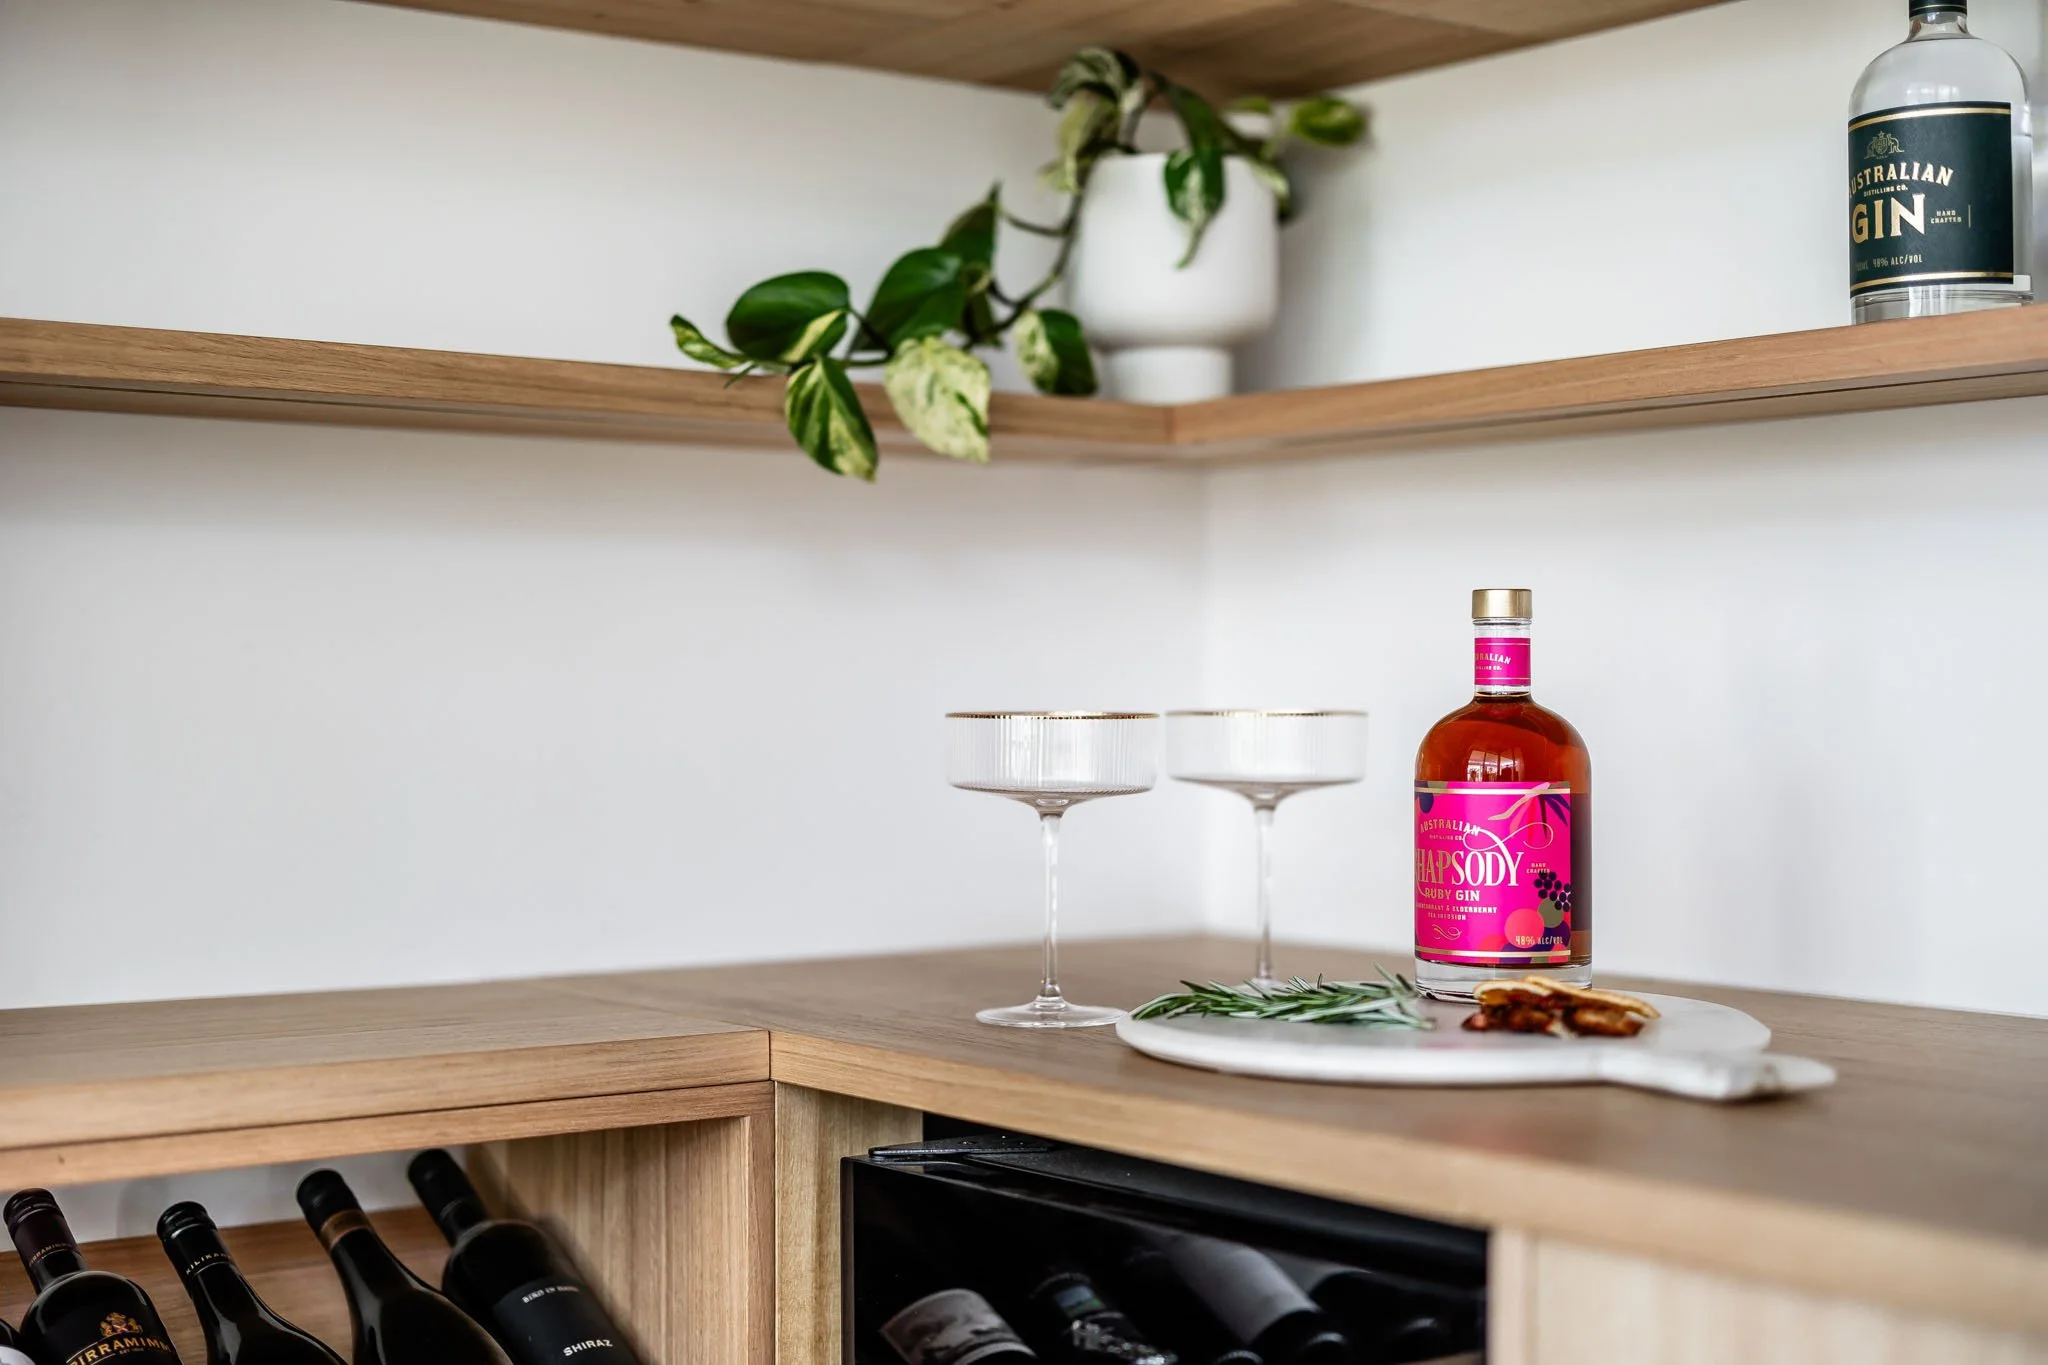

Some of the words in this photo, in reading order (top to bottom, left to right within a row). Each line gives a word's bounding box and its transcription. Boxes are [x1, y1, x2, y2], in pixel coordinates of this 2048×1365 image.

[1864, 185, 1895, 197] DISTILLING
[1852, 193, 1925, 244] GIN
[1930, 216, 1962, 224] CRAFTED
[1890, 254, 1923, 266] ALC/VOL
[1420, 818, 1481, 836] AUSTRALIAN
[1415, 848, 1524, 887] HAPSODY
[1424, 887, 1452, 900] RUBY
[1455, 889, 1481, 902] GIN
[1515, 936, 1535, 946] 48%
[563, 1339, 614, 1357] SHIRAZ
